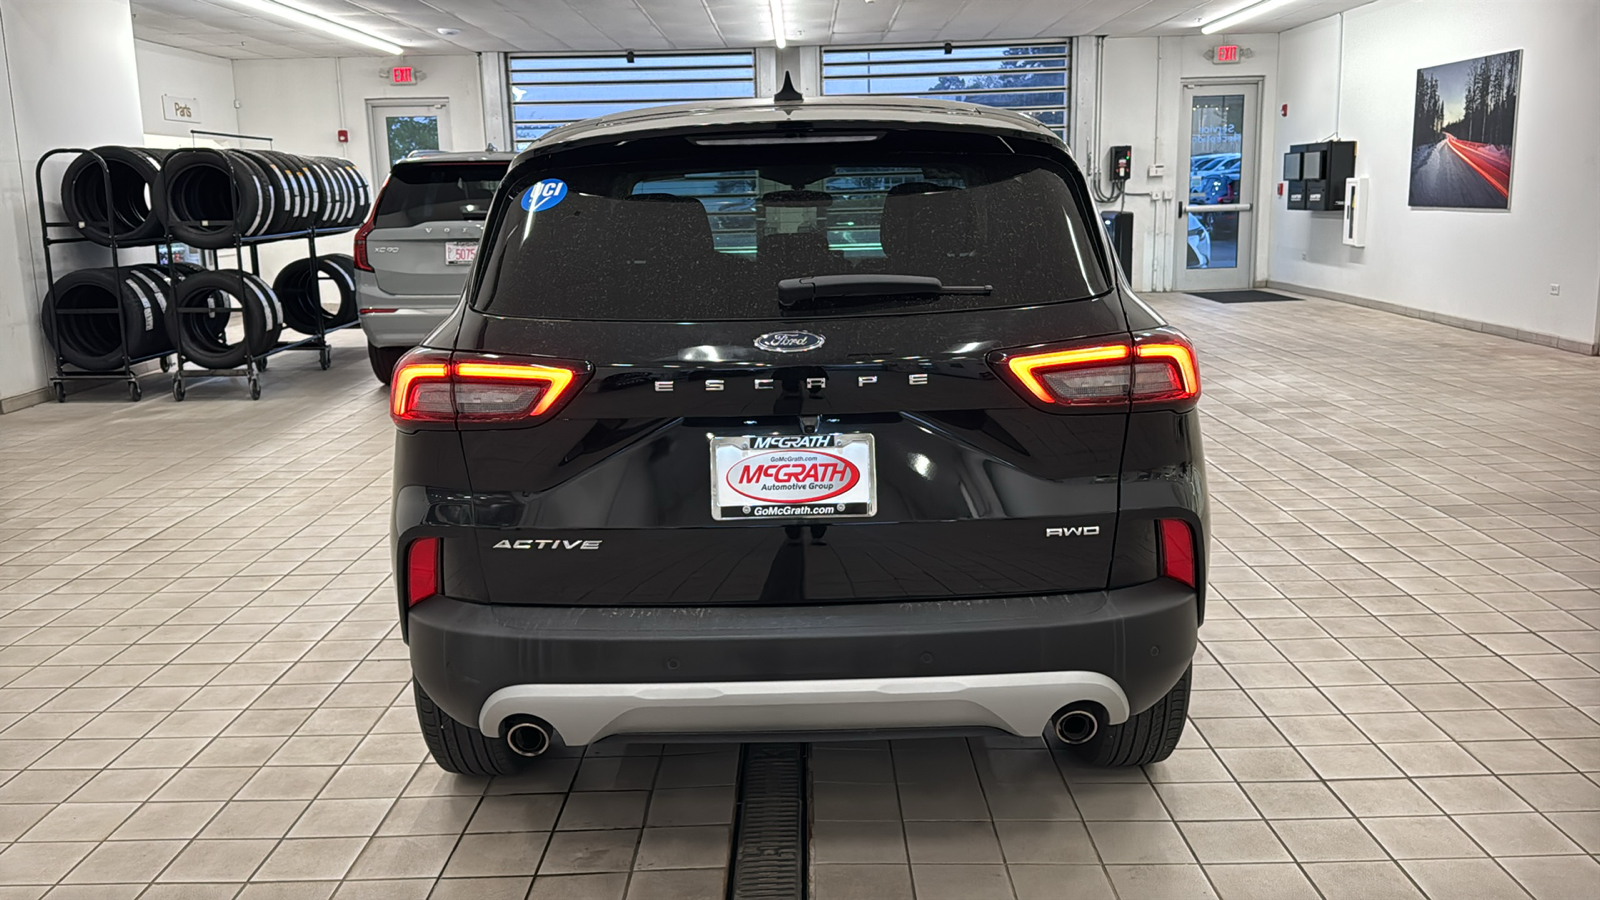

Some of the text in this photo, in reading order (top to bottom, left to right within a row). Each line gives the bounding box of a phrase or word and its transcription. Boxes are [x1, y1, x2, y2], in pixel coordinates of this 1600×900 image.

[1218, 45, 1238, 61] EXIT
[392, 66, 412, 83] EXIT
[174, 102, 192, 118] Parts
[770, 334, 808, 346] Ford
[654, 373, 929, 392] ESCAPE
[761, 482, 834, 491] Automotive Group
[754, 506, 835, 516] GoMcGrath.com
[1045, 525, 1100, 538] AWD
[492, 539, 603, 550] ACTIVE
